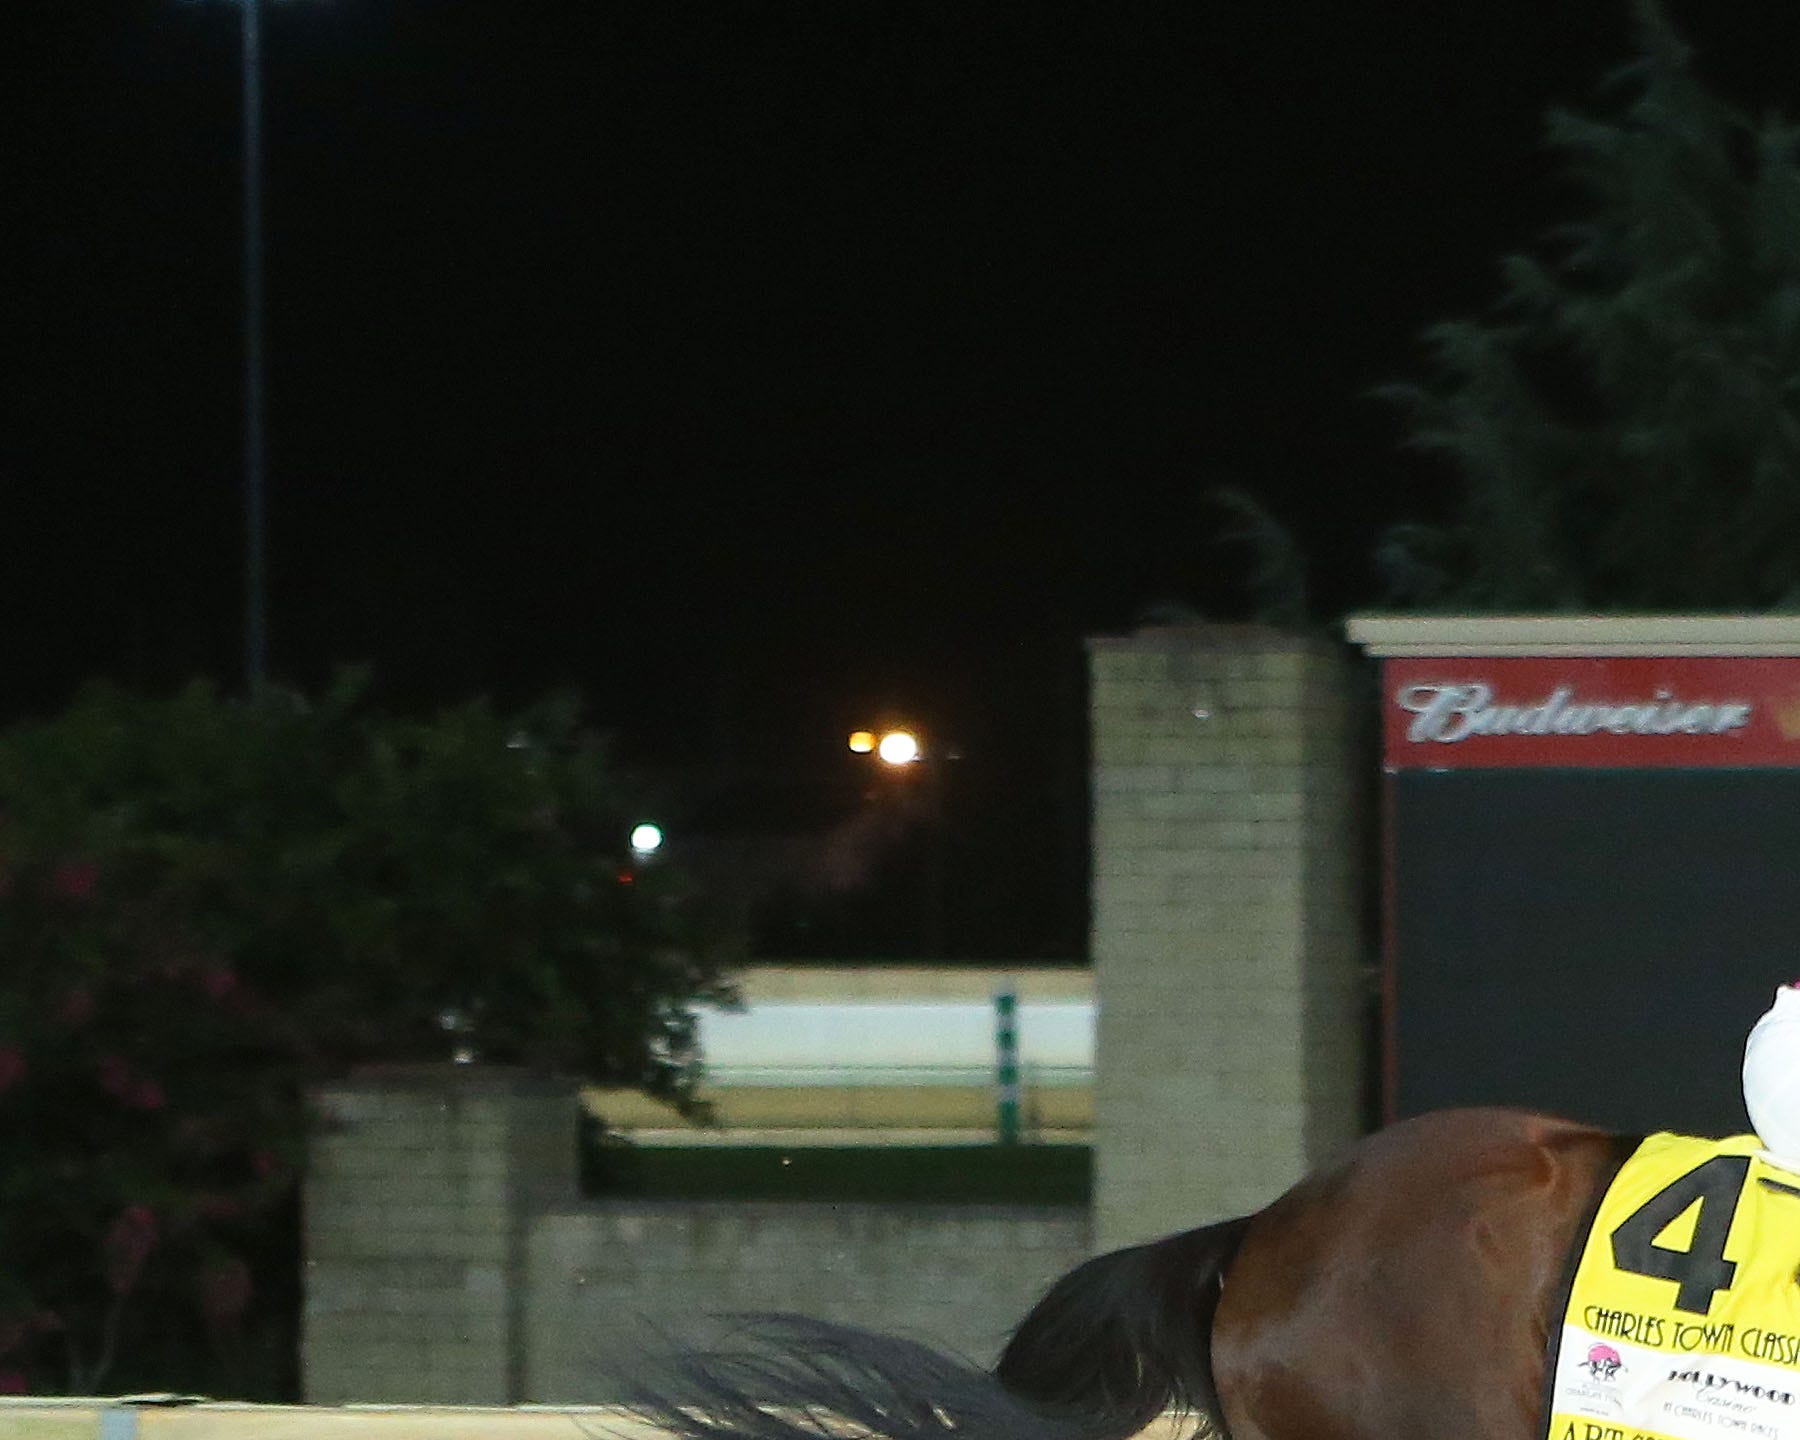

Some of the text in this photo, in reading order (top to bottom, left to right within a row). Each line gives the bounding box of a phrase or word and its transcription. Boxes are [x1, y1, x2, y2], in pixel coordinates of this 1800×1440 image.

[1400, 681, 1752, 744] Budweiser
[1611, 1153, 1755, 1316] 4
[1583, 1304, 1666, 1348] CHARLES
[1673, 1321, 1734, 1353] TOWN
